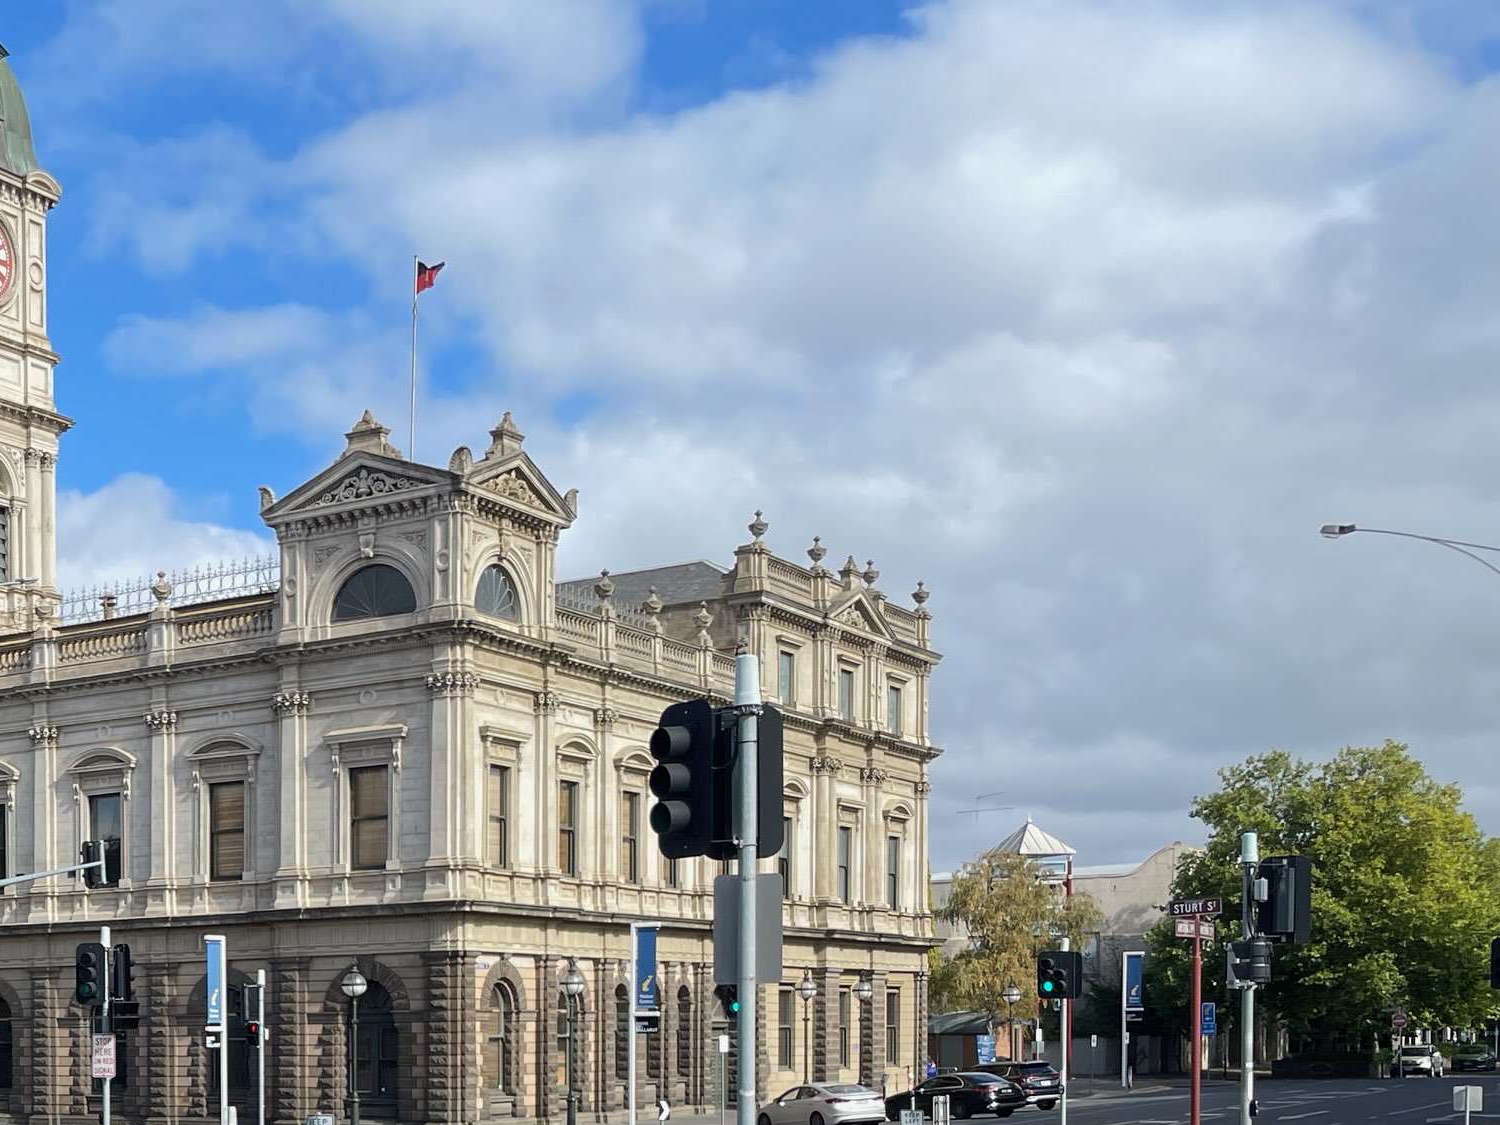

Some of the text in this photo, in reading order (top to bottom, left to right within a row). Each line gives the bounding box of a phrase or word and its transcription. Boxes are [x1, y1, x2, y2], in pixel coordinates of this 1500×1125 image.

[1173, 901, 1217, 914] STURT ST
[95, 1037, 112, 1046] STOP
[94, 1047, 112, 1056] HERE
